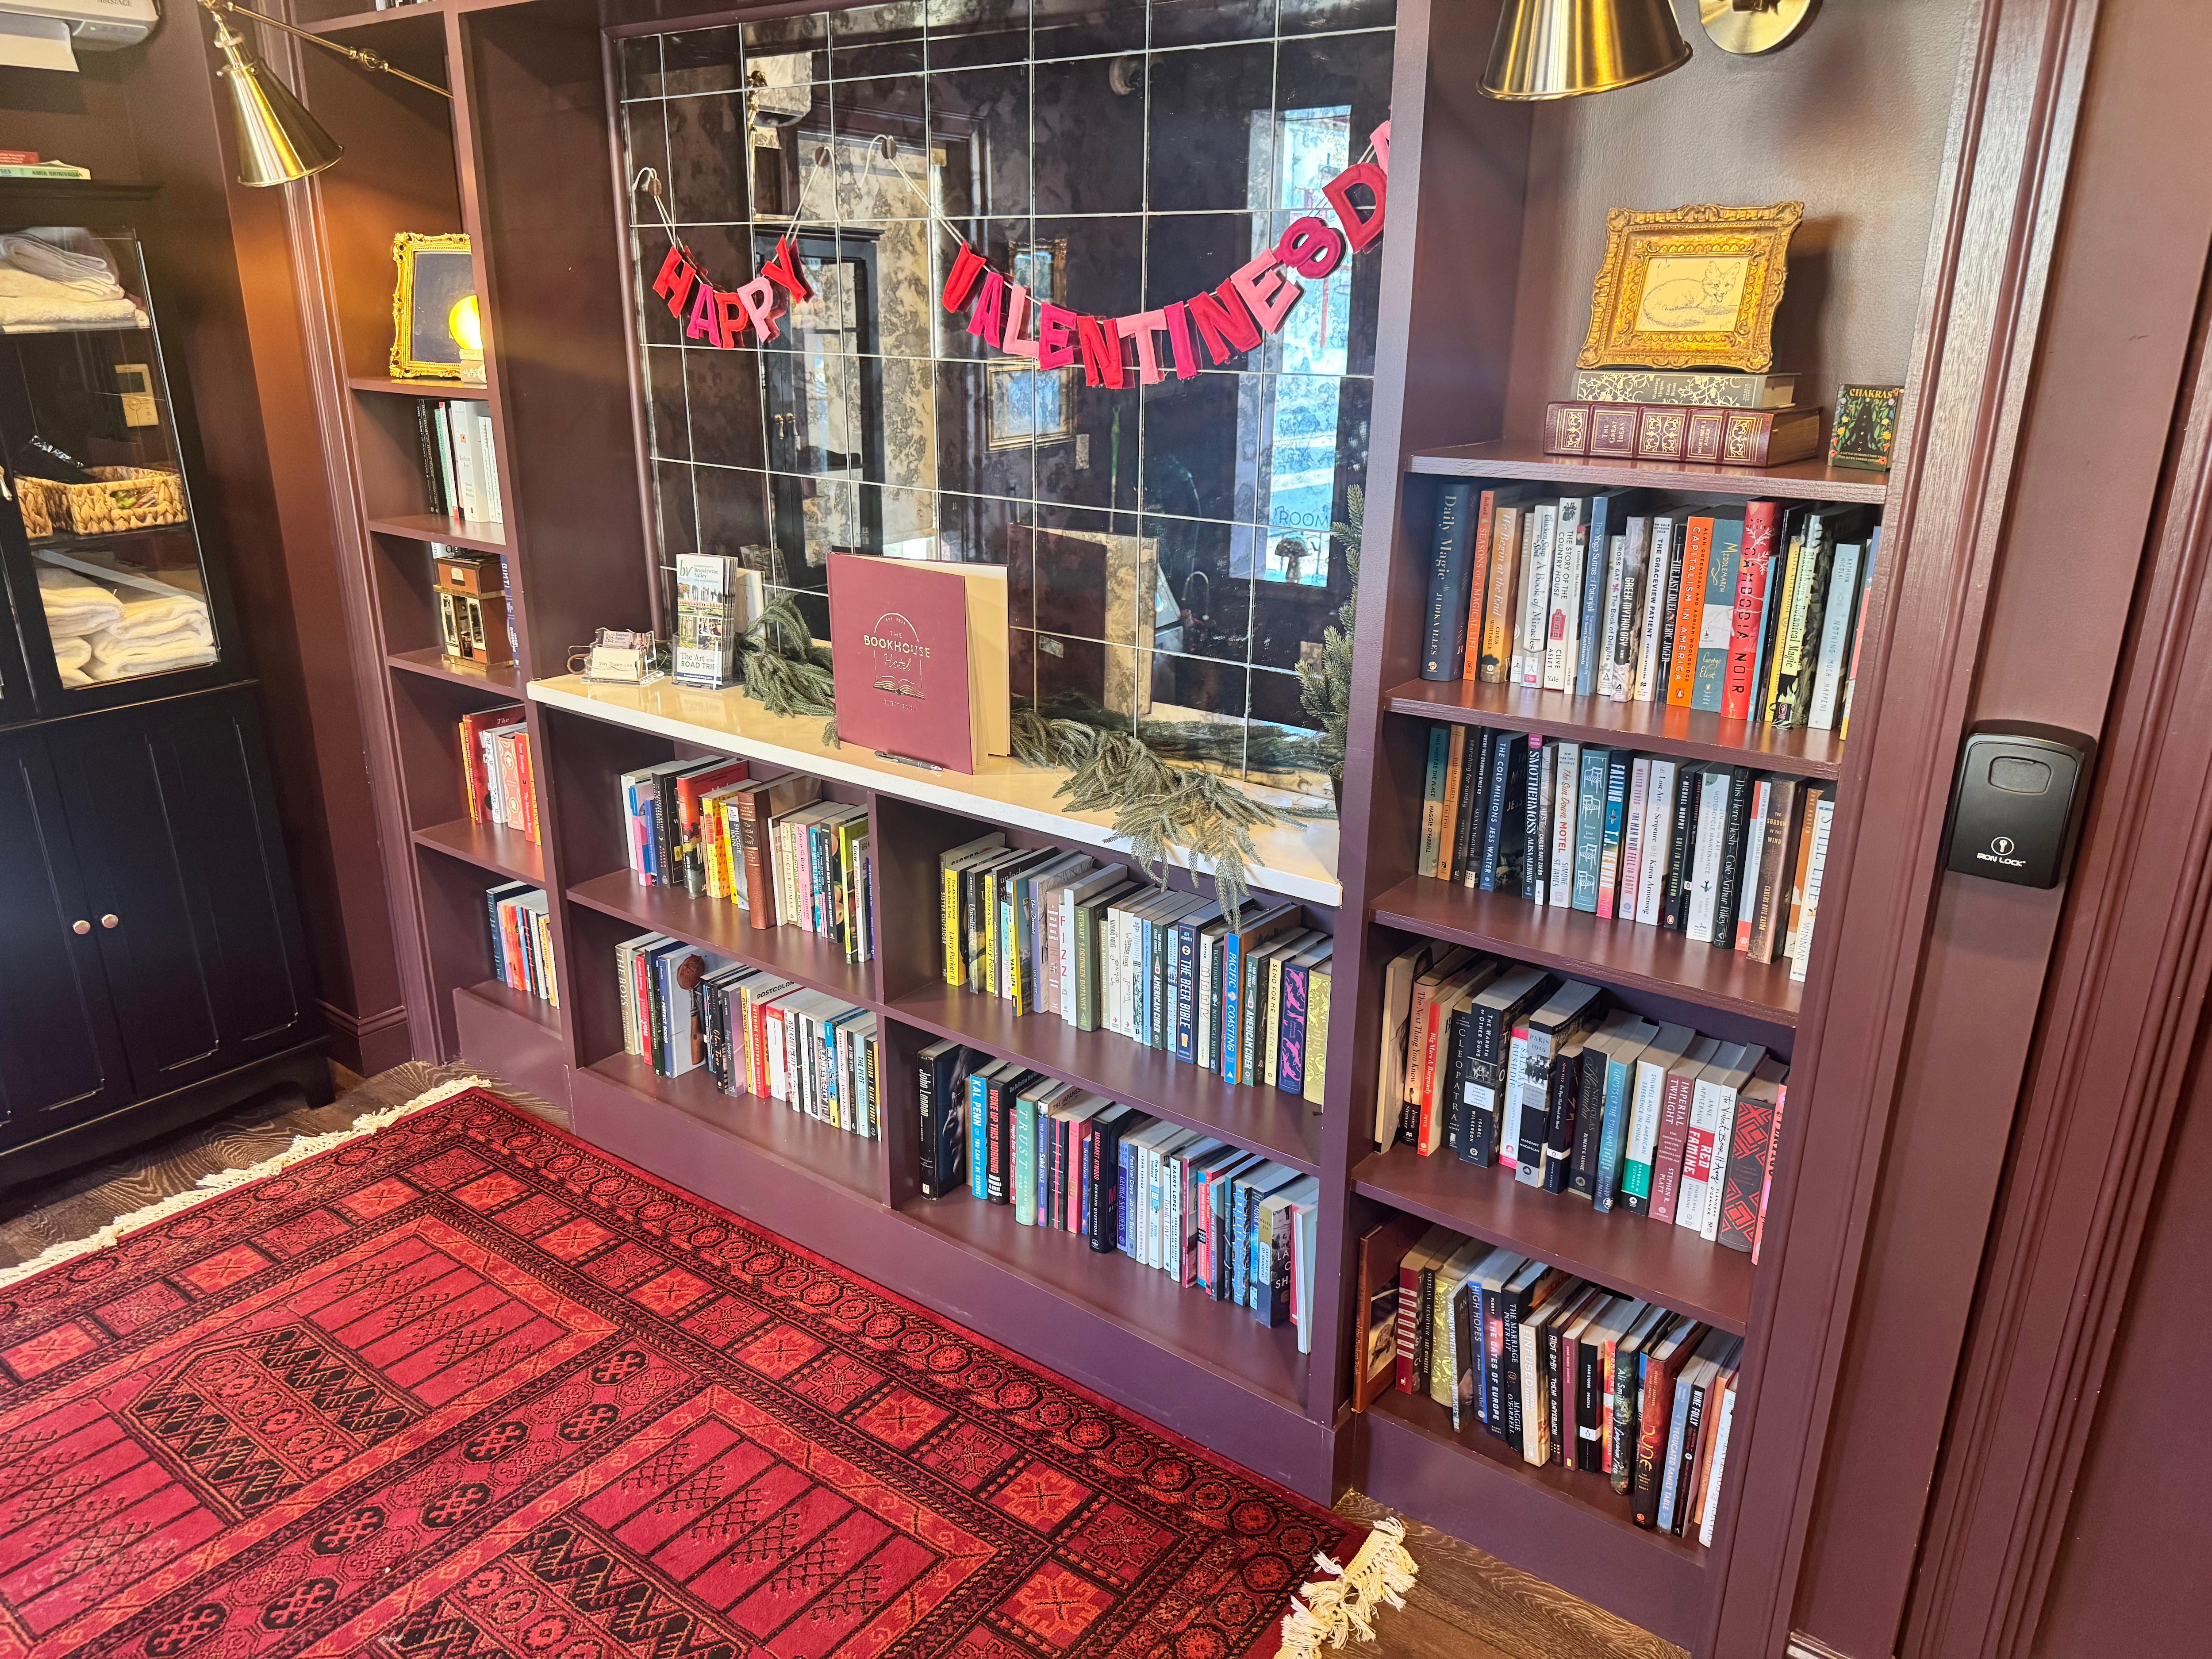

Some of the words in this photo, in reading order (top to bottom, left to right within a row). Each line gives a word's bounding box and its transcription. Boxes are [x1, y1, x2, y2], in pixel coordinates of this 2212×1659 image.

[653, 234, 807, 349] HAPPY
[1849, 388, 1893, 399] CHAKRAS
[1617, 422, 1626, 443] IDEAS
[1697, 424, 1706, 454] MORTIMER
[1439, 495, 1457, 537] Daily
[1435, 538, 1453, 580] Magic
[1537, 561, 1546, 569] A
[1555, 532, 1564, 569] COUNTRY
[1564, 547, 1573, 572] STORY
[1683, 526, 1701, 602] CAPITALISM
[501, 563, 511, 588] BINTI
[1563, 574, 1569, 583] OF
[1650, 558, 1661, 604] GRACEVIEW
[1719, 542, 1739, 593] MIDDLEMARCH
[1797, 550, 1814, 603] Blackthorn's
[1535, 570, 1545, 599] Book
[1624, 577, 1635, 599] GREEK
[1736, 547, 1756, 640] CAMBODIA
[1432, 592, 1444, 628] JUDIKA
[1532, 600, 1541, 611] of
[1681, 608, 1689, 621] IN
[890, 630, 902, 639] THE
[1529, 612, 1541, 650] Miracles
[1620, 602, 1633, 647] MYTHOLOGY
[1647, 607, 1655, 638] PATIENT
[1791, 603, 1806, 642] Botanical
[864, 634, 931, 659] BOOKHOUSE
[1429, 630, 1439, 656] ILLES
[1674, 626, 1688, 680] AMERICA
[1786, 644, 1797, 667] Magic
[1732, 653, 1747, 694] NOIR
[1498, 743, 1506, 758] THE
[1495, 761, 1504, 783] COLD
[1607, 763, 1625, 803] FALLING
[1490, 786, 1502, 823] MILLIONS
[1558, 821, 1567, 853] MOTEL
[1651, 813, 1662, 842] Scripture
[1815, 816, 1833, 860] STILL
[1484, 846, 1493, 874] WALTER
[1647, 859, 1657, 879] Karen
[1725, 854, 1735, 874] Cole
[1976, 853, 1998, 862] IRON
[1720, 875, 1732, 904] Arthur
[1808, 865, 1822, 900] LIFE
[1641, 880, 1655, 915] Armstrong
[1717, 904, 1729, 926] Riley
[1796, 922, 1809, 960] WINMAN
[1180, 959, 1192, 976] THE
[1228, 952, 1238, 989] PACIFIC
[619, 979, 628, 1007] BOYS
[1153, 975, 1162, 1007] AMERICAN
[1180, 977, 1191, 1002] BEER
[1179, 1002, 1191, 1029] BIBLE
[1225, 1005, 1237, 1052] COASTING
[1245, 1009, 1255, 1040] AMERICAN
[1244, 1043, 1253, 1071] CIDER
[1509, 1043, 1520, 1087] RUSHDIE
[1517, 1047, 1528, 1089] SALMAN
[919, 1068, 931, 1086] John
[971, 1079, 981, 1098] KAL
[1450, 1029, 1467, 1121] CLEOPATRA
[920, 1086, 932, 1118] Lennon
[972, 1100, 982, 1128] PENN
[989, 1089, 998, 1110] WOKE
[1665, 1079, 1679, 1124] TWILIGHT
[1675, 1080, 1690, 1126] IMPERIAL
[1696, 1086, 1705, 1124] APPLEBAUM
[990, 1111, 998, 1123] UP
[990, 1123, 999, 1140] THIS
[1018, 1109, 1028, 1168] TRUST
[1684, 1130, 1701, 1175] FAMINE
[989, 1141, 999, 1174] MORNING
[1700, 1145, 1713, 1168] RED
[1471, 1285, 1480, 1310] HIGH
[1473, 1312, 1482, 1342] HOPES
[1490, 1342, 1499, 1370] GATES
[1491, 1372, 1498, 1383] OF
[1617, 1368, 1627, 1379] Ali
[1491, 1386, 1500, 1421] EUROPE
[1616, 1380, 1626, 1405] Smith
[1693, 1390, 1703, 1408] WINE
[1690, 1409, 1700, 1427] FOLLY
[1638, 1424, 1656, 1471] DUNE
[1669, 1426, 1680, 1466] VEGUCATED
[1666, 1467, 1675, 1490] FAMILY
[1662, 1490, 1671, 1510] TABLE
